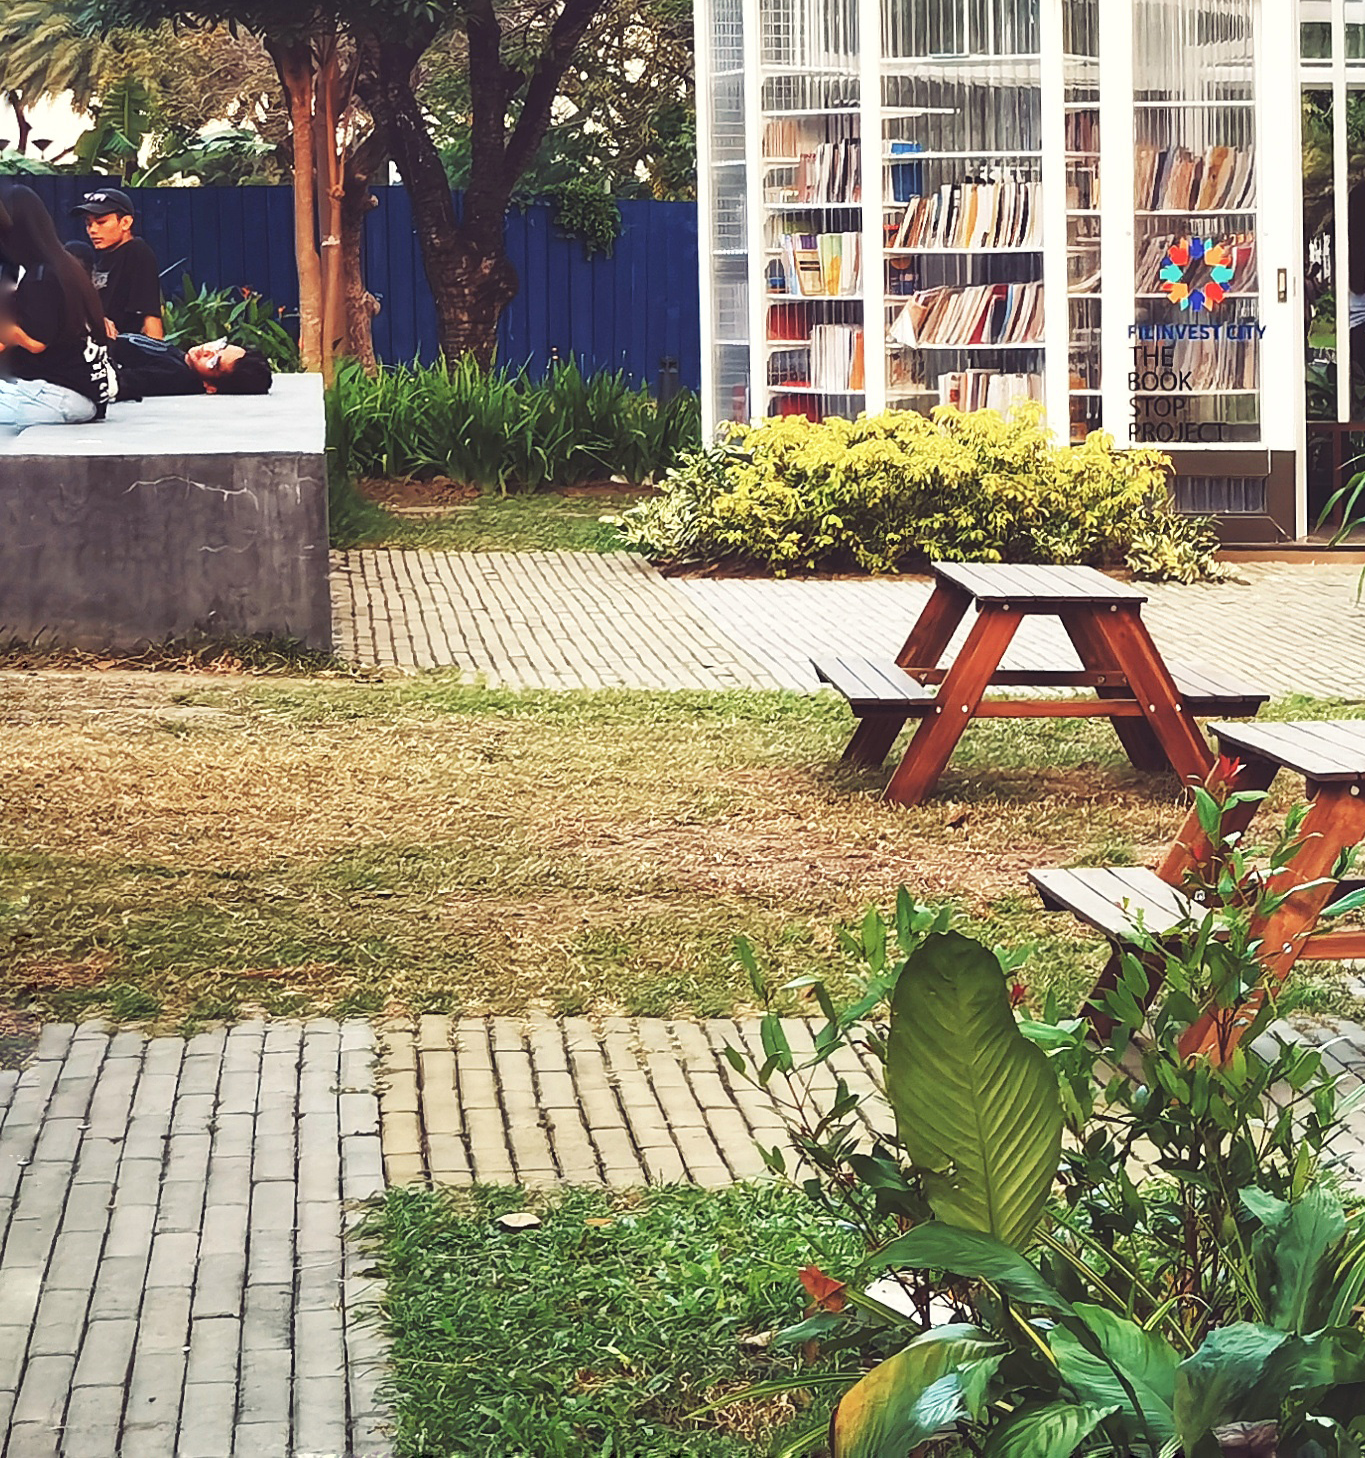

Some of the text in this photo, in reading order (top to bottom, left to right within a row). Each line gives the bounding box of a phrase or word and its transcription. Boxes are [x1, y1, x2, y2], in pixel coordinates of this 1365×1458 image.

[1128, 324, 1266, 340] FILINVEST CITY
[1129, 346, 1174, 367] THE
[1128, 371, 1193, 391] BOOK
[1129, 397, 1185, 417] STOP
[1128, 422, 1226, 442] PROJECT
